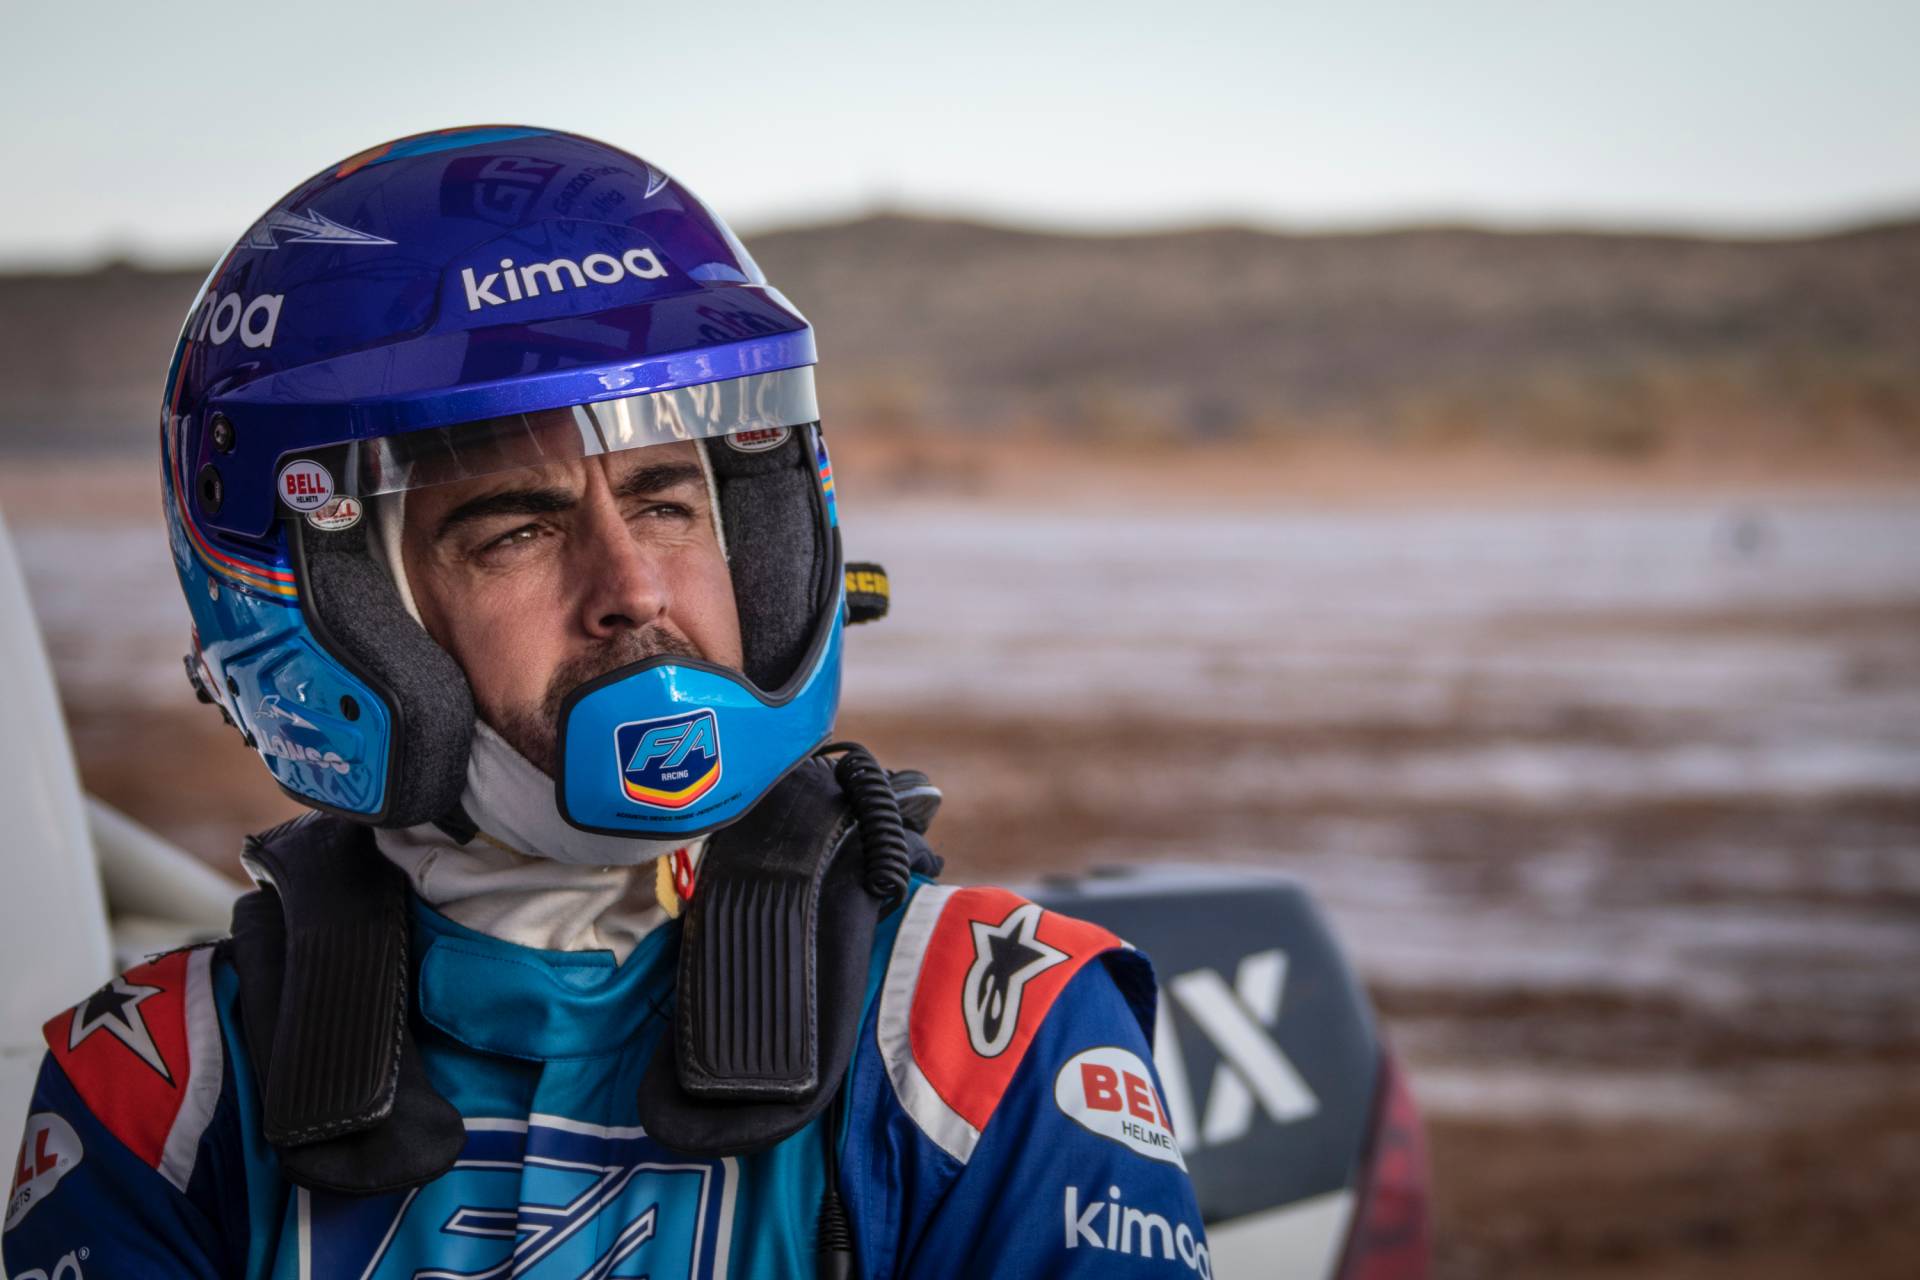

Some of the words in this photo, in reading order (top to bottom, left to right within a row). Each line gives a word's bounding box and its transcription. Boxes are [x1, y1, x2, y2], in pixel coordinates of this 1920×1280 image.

[461, 247, 669, 312] kimoa
[186, 289, 285, 348] moa
[286, 473, 326, 495] BELL
[625, 714, 717, 772] FA
[661, 769, 689, 782] RACING
[1121, 1120, 1175, 1151] HELME
